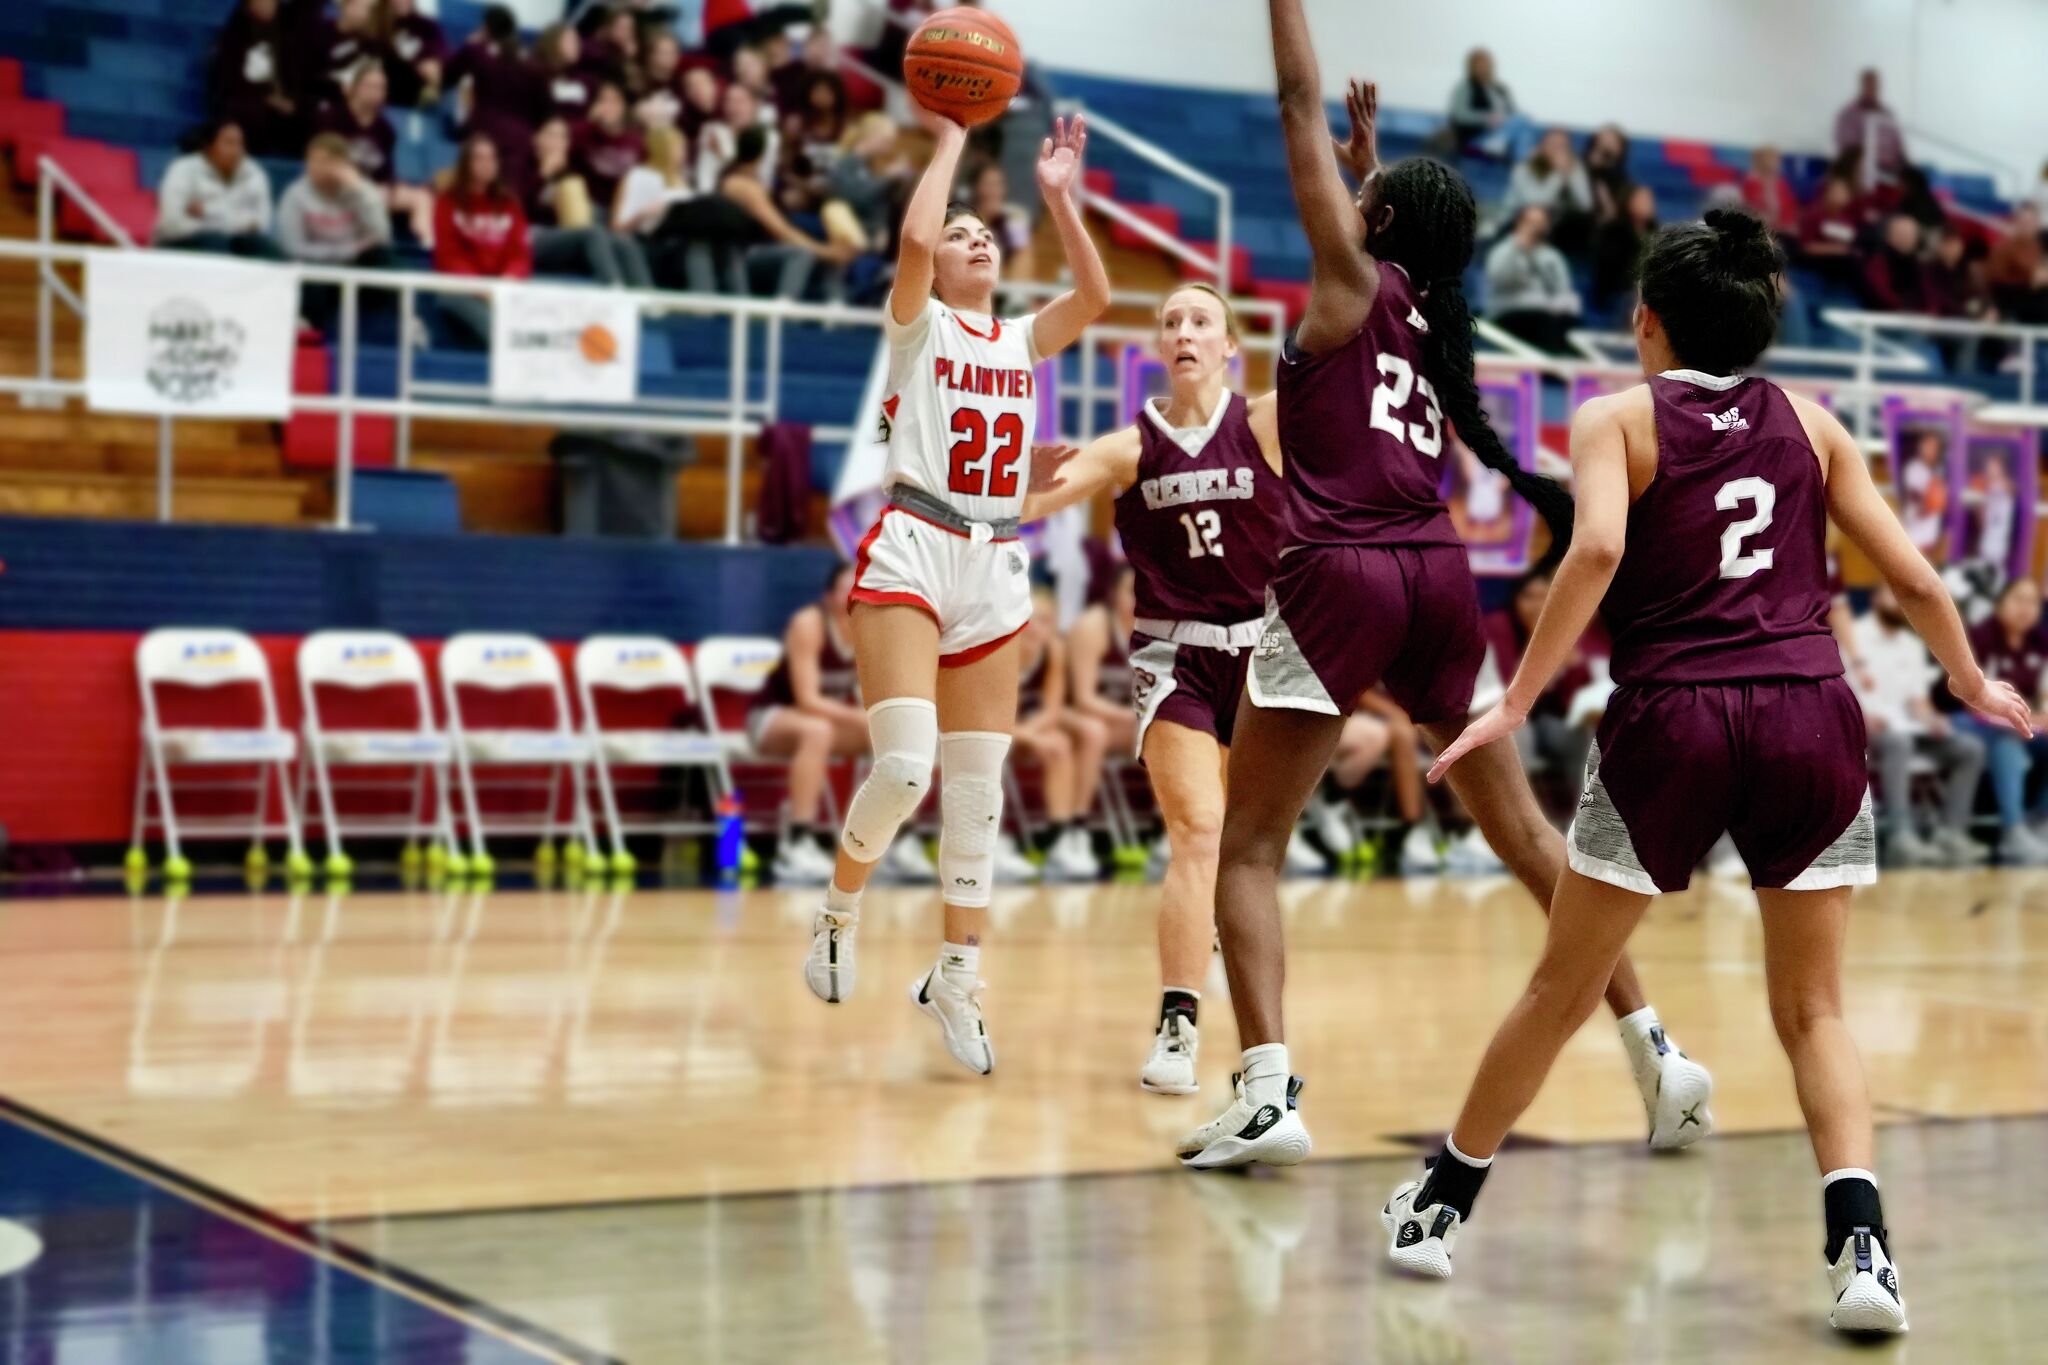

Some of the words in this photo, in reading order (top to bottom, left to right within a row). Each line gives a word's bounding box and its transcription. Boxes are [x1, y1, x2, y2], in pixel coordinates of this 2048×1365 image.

[1369, 352, 1442, 459] 23
[948, 407, 1024, 497] 22
[1141, 466, 1254, 511] REBELS
[1179, 508, 1224, 559] 12
[1714, 476, 1776, 580] 2
